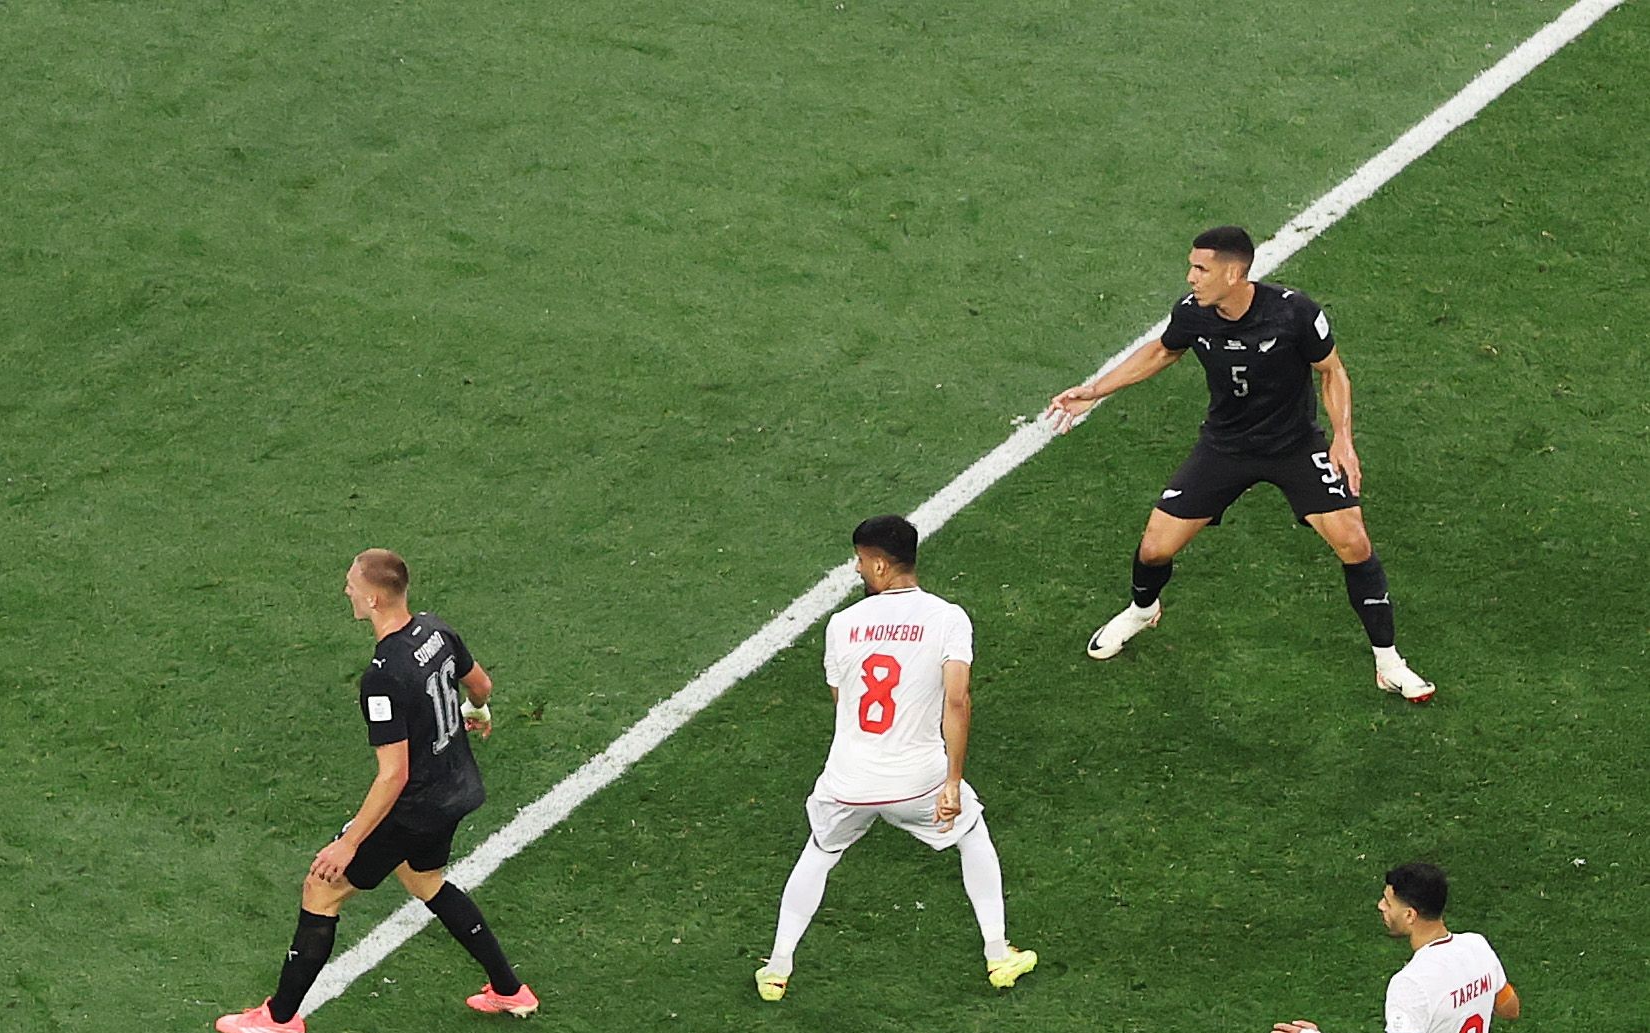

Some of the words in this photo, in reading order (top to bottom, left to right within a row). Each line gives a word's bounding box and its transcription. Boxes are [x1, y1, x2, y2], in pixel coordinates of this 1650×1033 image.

[1231, 366, 1249, 397] 5
[1311, 451, 1338, 484] 5
[426, 655, 460, 755] 16
[858, 653, 902, 735] 8
[1450, 973, 1492, 1009] TAREMI
